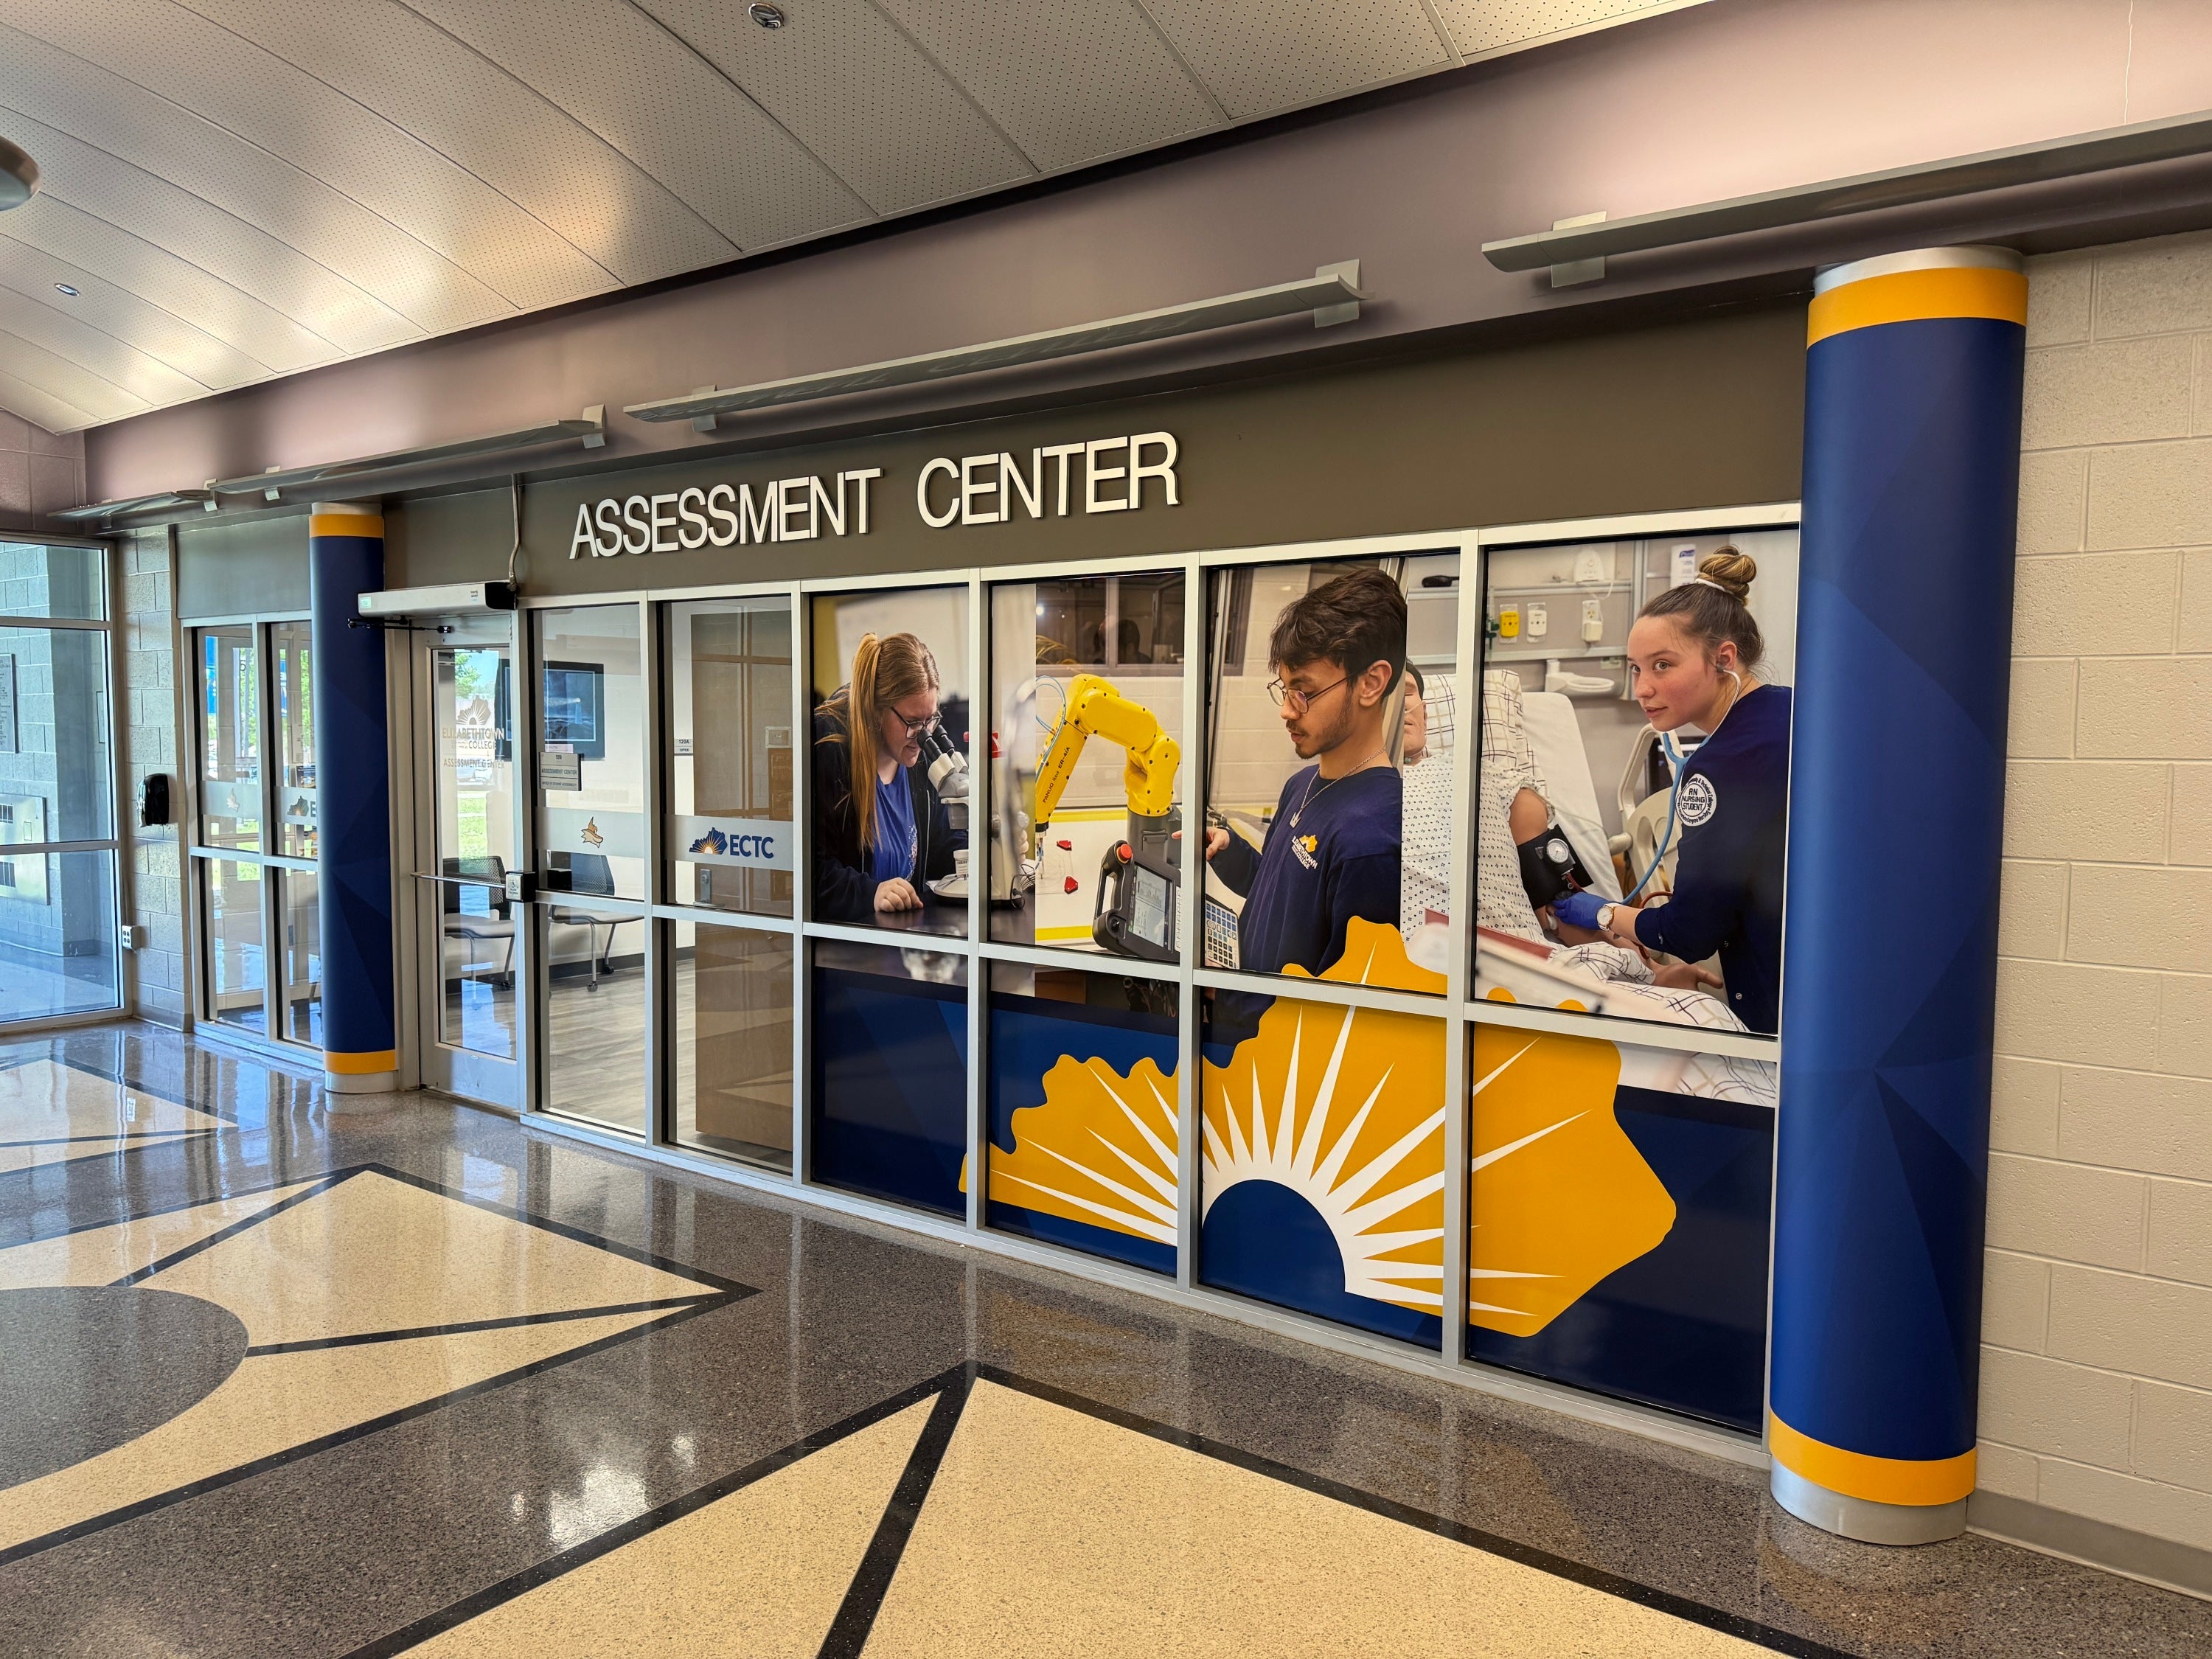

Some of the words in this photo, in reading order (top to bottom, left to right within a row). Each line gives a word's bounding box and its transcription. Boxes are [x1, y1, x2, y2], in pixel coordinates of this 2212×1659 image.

[568, 467, 881, 559] ASSESSMENT
[917, 431, 1180, 529] CENTER
[442, 727, 504, 740] ELIZABETHTOWN
[468, 740, 496, 749] COLLEGE
[444, 757, 480, 768] ASSESSMENT
[1682, 802, 1703, 811] STUDENT
[730, 834, 774, 859] ECTC
